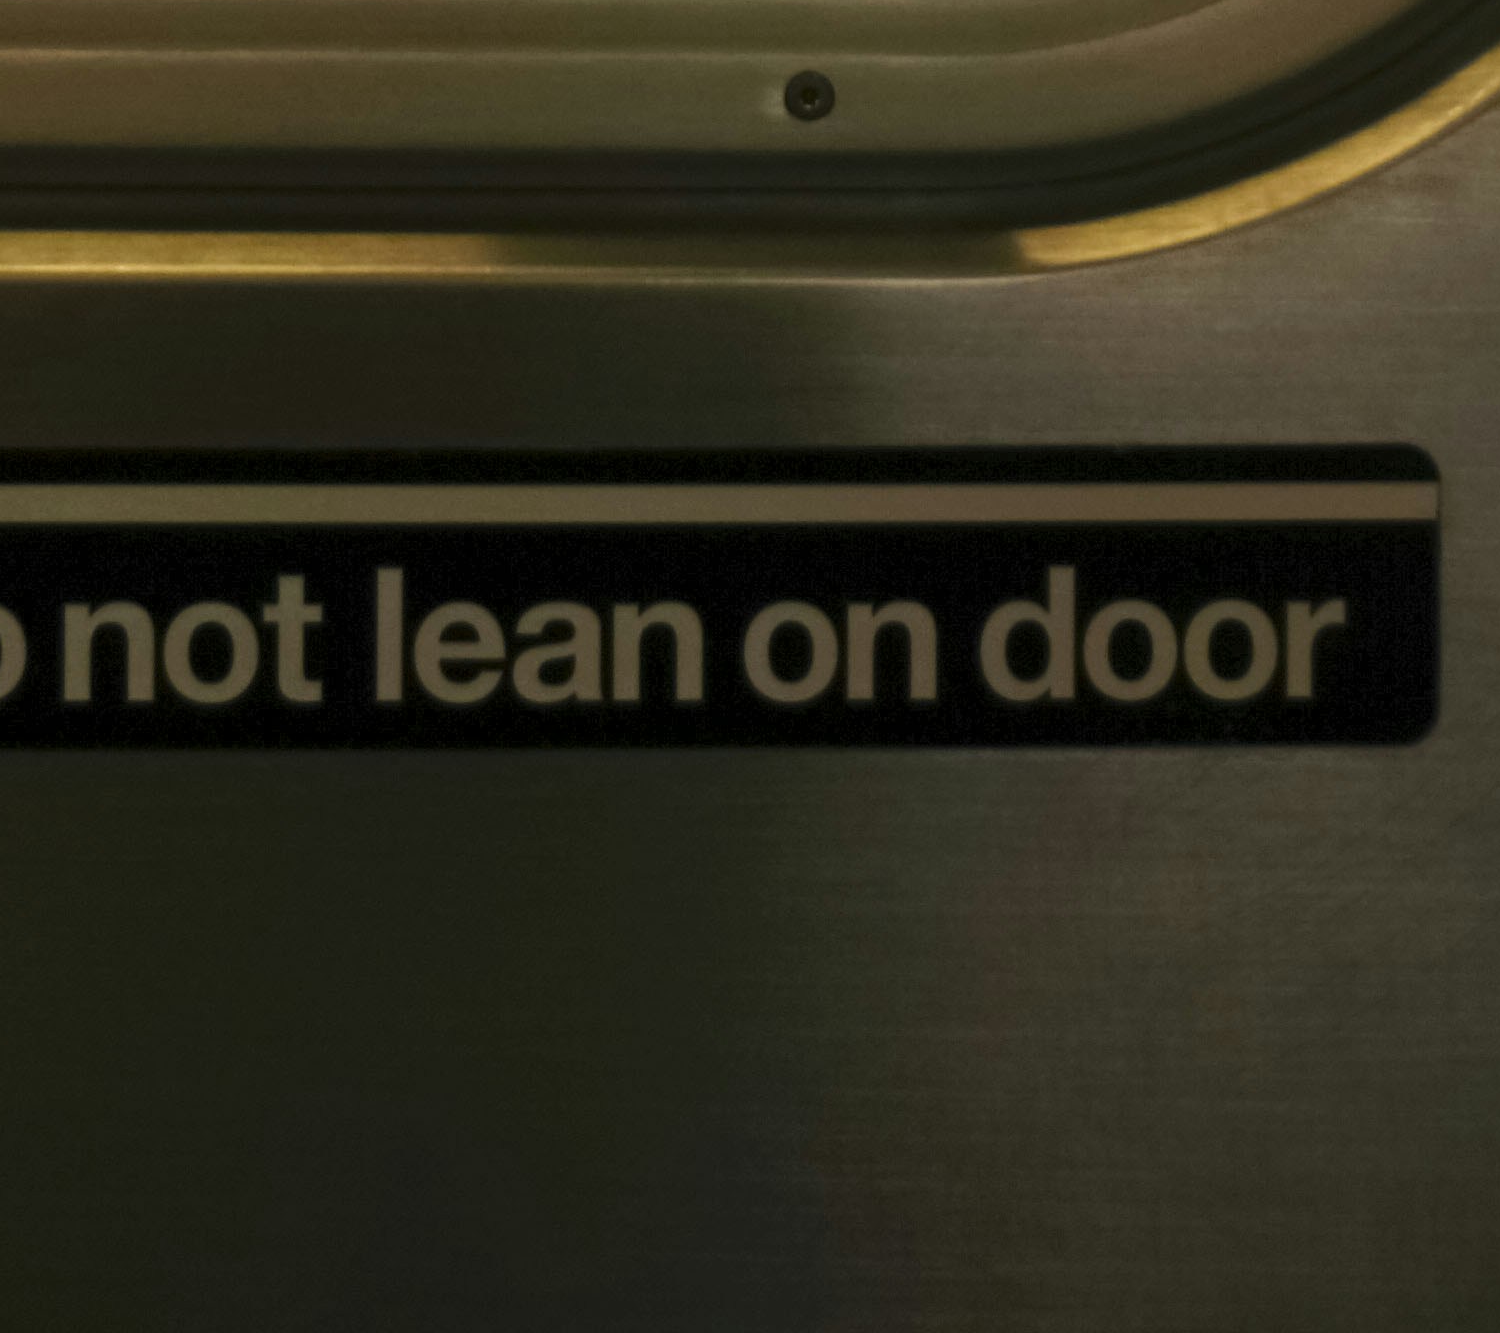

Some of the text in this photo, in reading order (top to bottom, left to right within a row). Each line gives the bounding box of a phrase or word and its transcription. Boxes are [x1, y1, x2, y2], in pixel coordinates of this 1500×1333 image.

[63, 576, 320, 702] not
[376, 568, 702, 702] lean
[744, 603, 935, 701] on
[980, 568, 1343, 700] door
